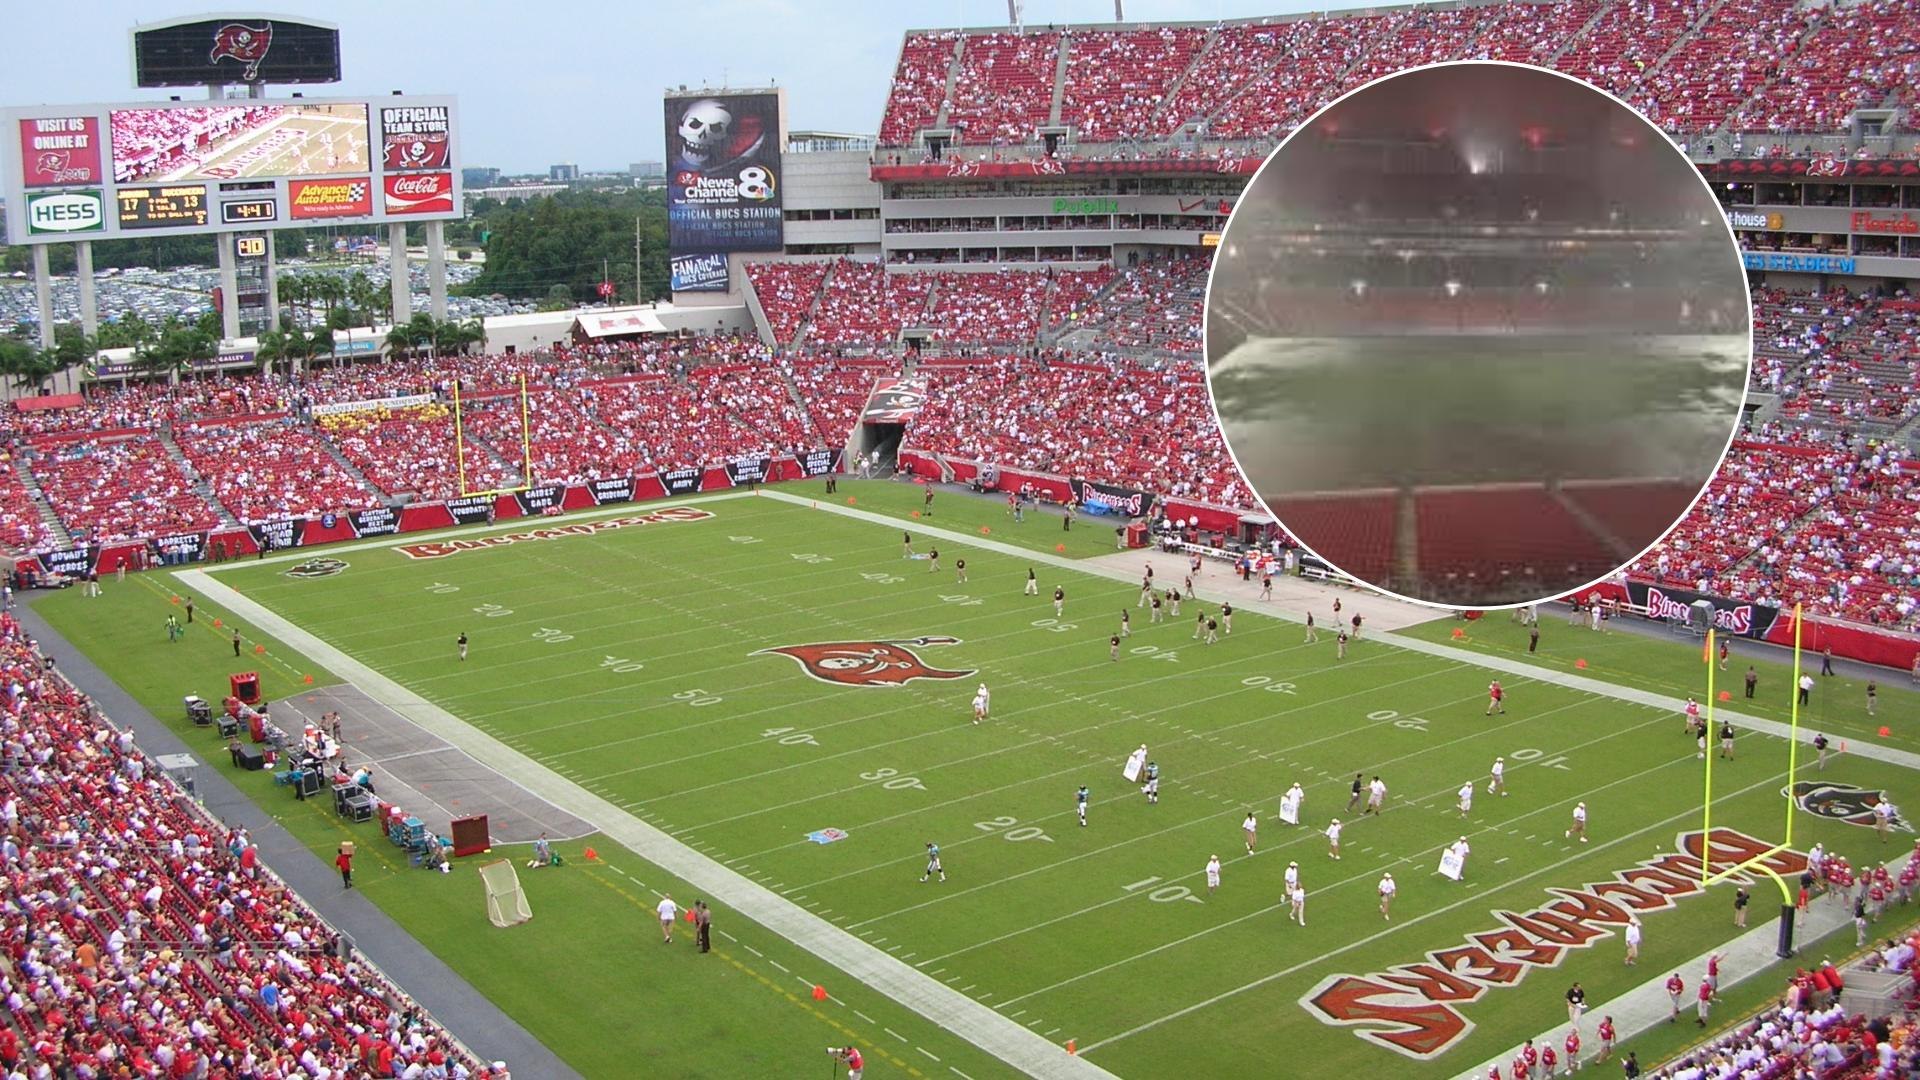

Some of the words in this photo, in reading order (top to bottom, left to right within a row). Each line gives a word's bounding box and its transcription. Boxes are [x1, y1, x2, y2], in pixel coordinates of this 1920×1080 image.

[384, 108, 447, 123] OFFICIAL
[36, 119, 67, 132] VISIT
[68, 118, 85, 131] US
[384, 122, 413, 133] TEAM
[414, 121, 447, 132] STORE
[34, 136, 74, 149] ONLINE
[75, 135, 88, 148] AT
[300, 185, 348, 196] Advance
[697, 177, 734, 188] News
[739, 167, 768, 198] 8
[294, 195, 319, 204] Auto
[685, 185, 738, 198] Channel
[124, 199, 138, 210] 17
[184, 195, 198, 207] 13
[1054, 197, 1118, 214] Publix
[36, 203, 95, 221] HESS
[197, 215, 204, 224] 2
[670, 208, 712, 219] OFFICIAL
[715, 208, 740, 219] BUCS
[743, 207, 780, 218] STATION
[240, 239, 264, 255] 40
[671, 254, 721, 277] FANATICAL
[1770, 256, 1855, 273] STADIUM
[261, 521, 294, 533] DAVID'S
[1647, 587, 1752, 634] BUCCERS
[600, 656, 643, 673] 40
[673, 688, 722, 707] 50
[1367, 710, 1430, 730] 20
[760, 726, 813, 747] 40
[1510, 749, 1569, 769] 10
[860, 767, 920, 790] 30
[974, 816, 1044, 842] 20
[1122, 876, 1191, 903] 10
